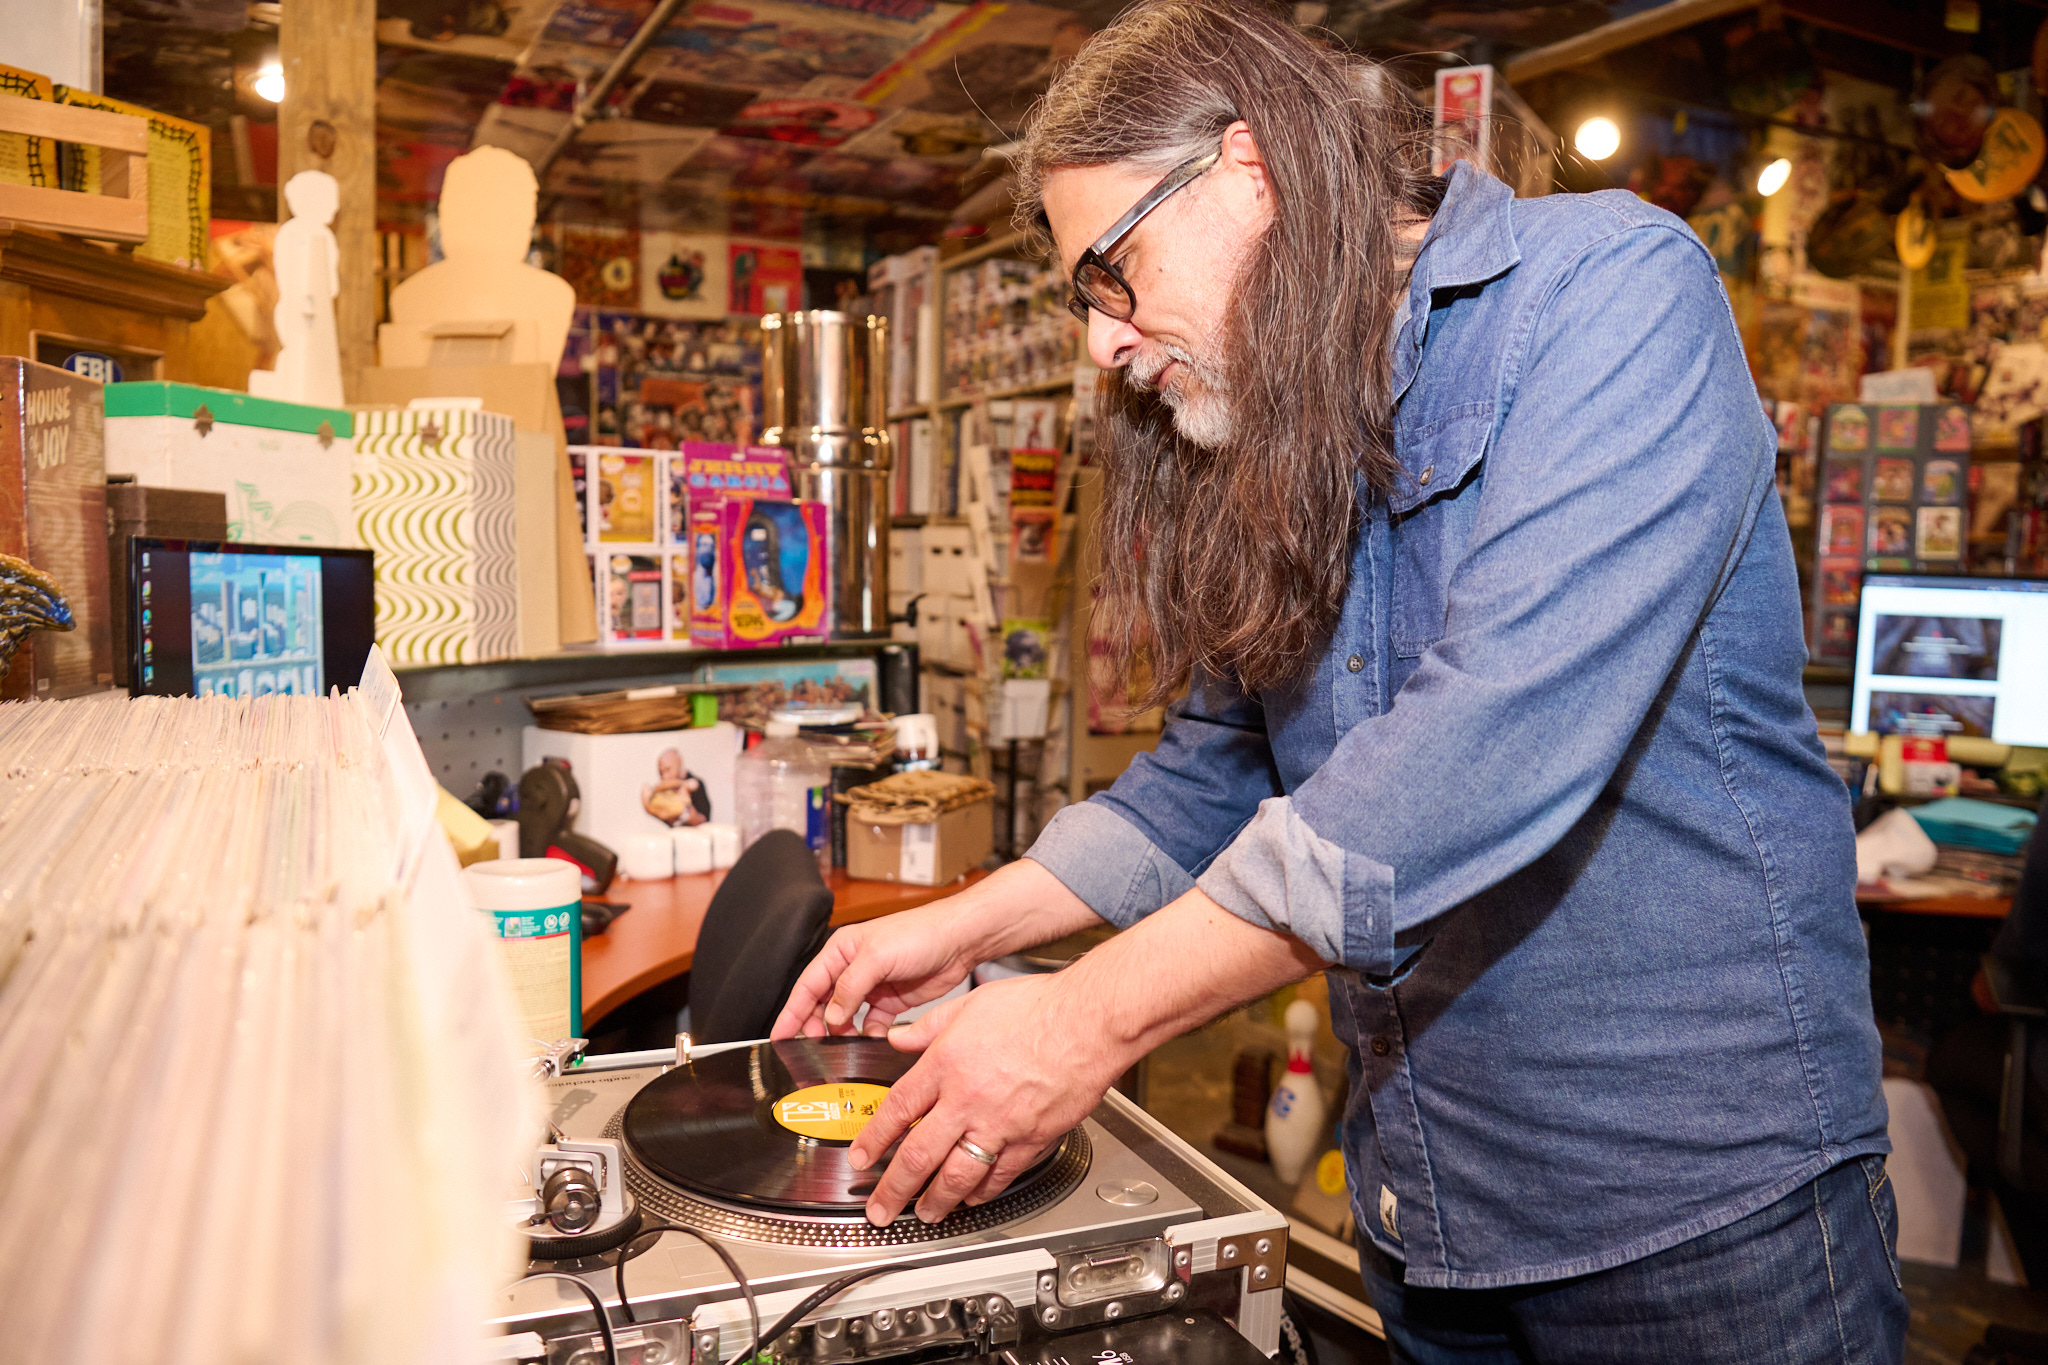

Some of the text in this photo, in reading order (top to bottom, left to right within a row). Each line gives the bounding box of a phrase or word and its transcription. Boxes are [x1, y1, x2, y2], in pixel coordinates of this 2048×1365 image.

[75, 355, 114, 385] FBI
[26, 386, 71, 426] HOUSE
[38, 424, 70, 470] JOY
[688, 459, 784, 476] JERRY
[690, 473, 788, 490] GARCIA
